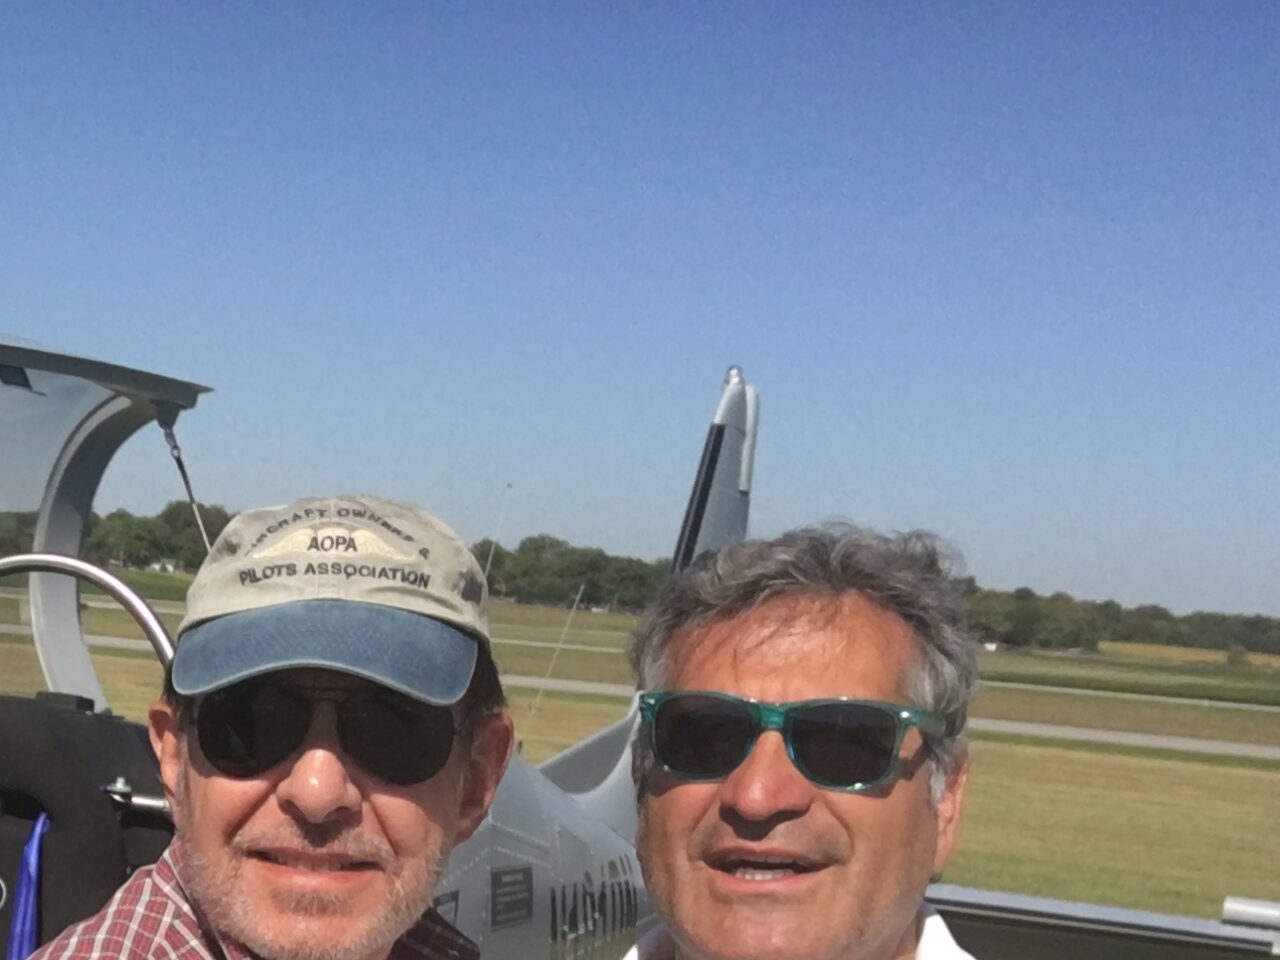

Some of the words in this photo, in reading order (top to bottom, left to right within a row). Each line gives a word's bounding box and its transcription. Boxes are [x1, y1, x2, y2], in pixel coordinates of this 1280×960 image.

[336, 507, 416, 543] OWNERS
[307, 535, 358, 552] AOPA
[239, 562, 297, 586] PILOTS
[304, 562, 431, 590] ASSOCIATION
